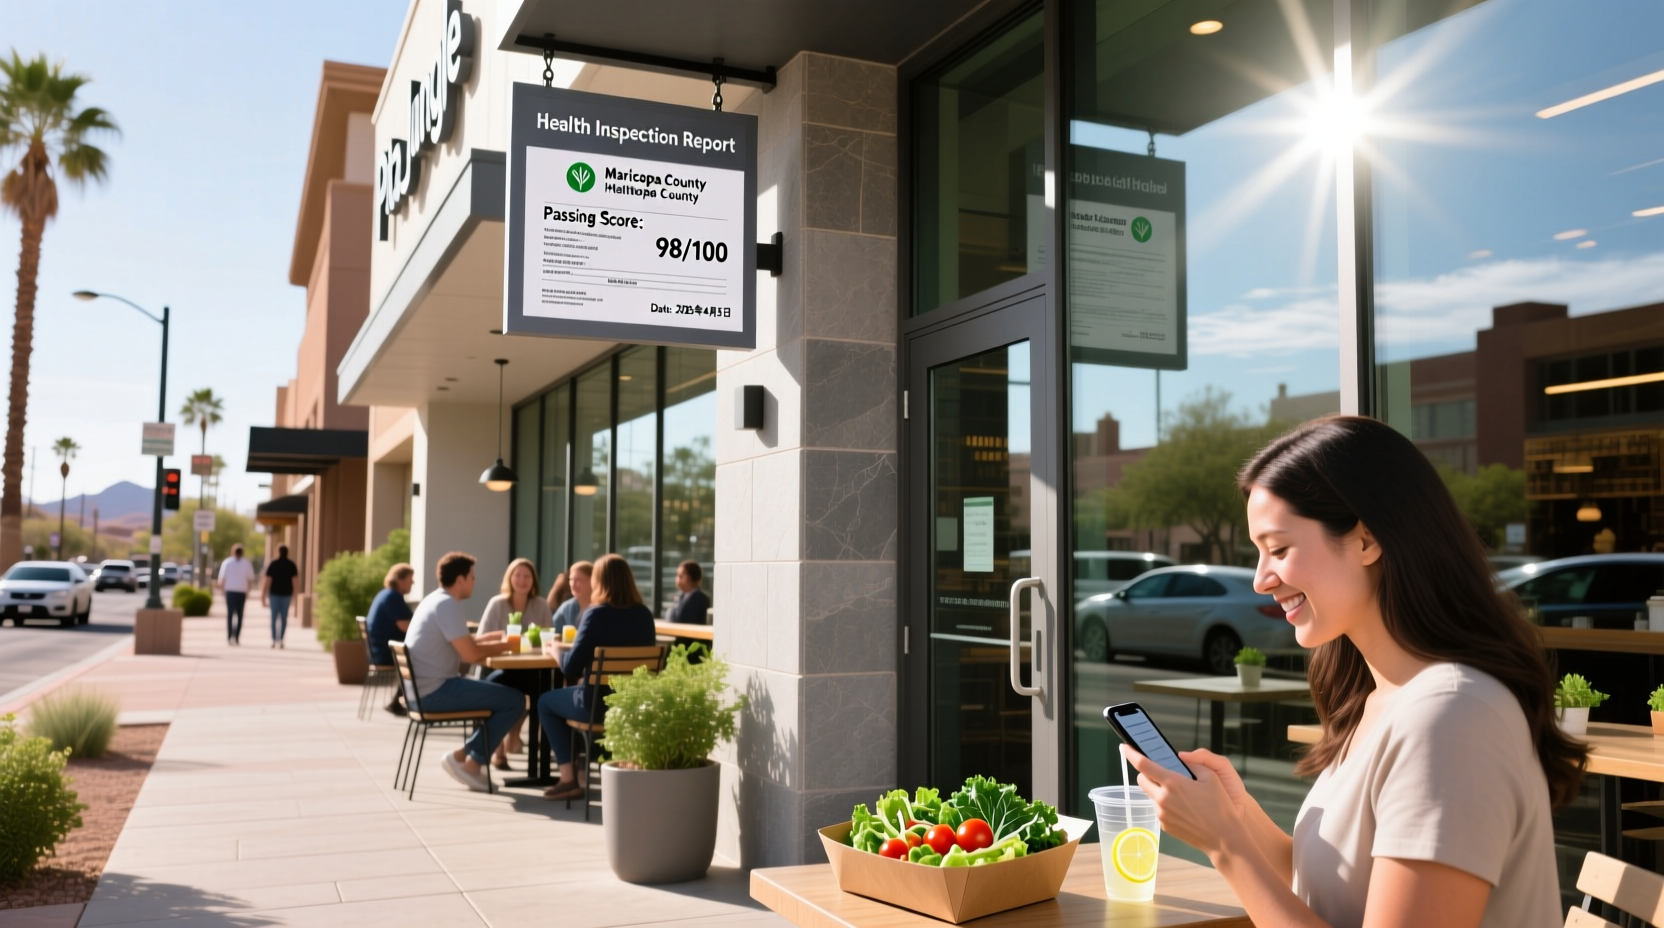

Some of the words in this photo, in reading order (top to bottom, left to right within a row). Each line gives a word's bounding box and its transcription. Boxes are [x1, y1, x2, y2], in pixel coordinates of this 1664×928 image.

[537, 112, 591, 135] Health
[595, 120, 679, 145] Inspection
[683, 131, 736, 154] Report
[605, 167, 662, 187] Maricopa
[664, 174, 707, 192] County
[660, 188, 699, 205] County
[543, 206, 597, 227] Passing
[599, 211, 644, 229] Score:
[655, 237, 728, 263] 98/100
